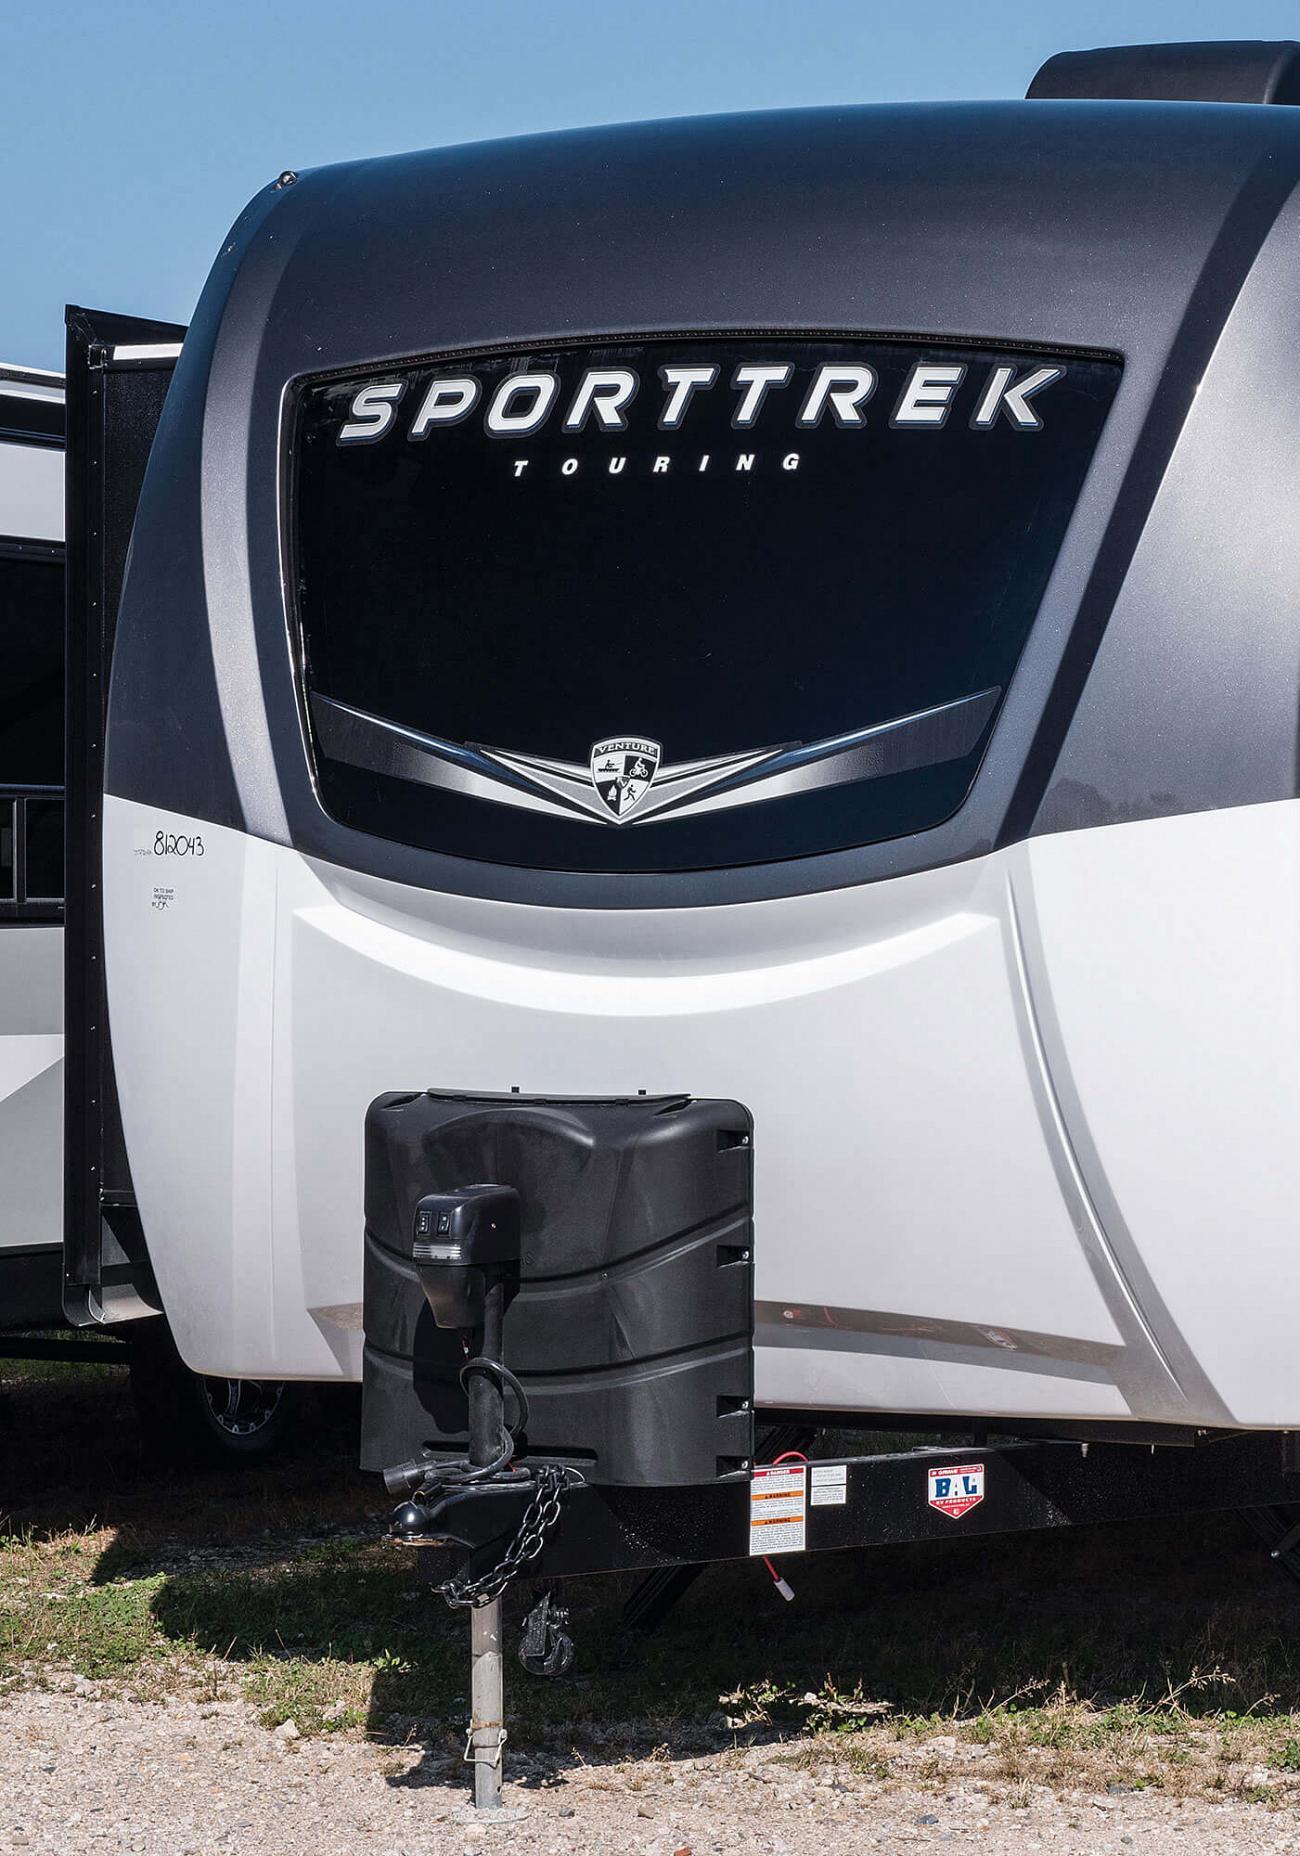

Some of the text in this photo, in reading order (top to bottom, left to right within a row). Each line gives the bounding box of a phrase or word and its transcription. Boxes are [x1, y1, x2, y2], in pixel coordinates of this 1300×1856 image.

[337, 365, 1063, 443] SPORTTREK
[513, 453, 800, 477] TOURING
[599, 742, 656, 756] VENTURE
[153, 830, 205, 856] 812043
